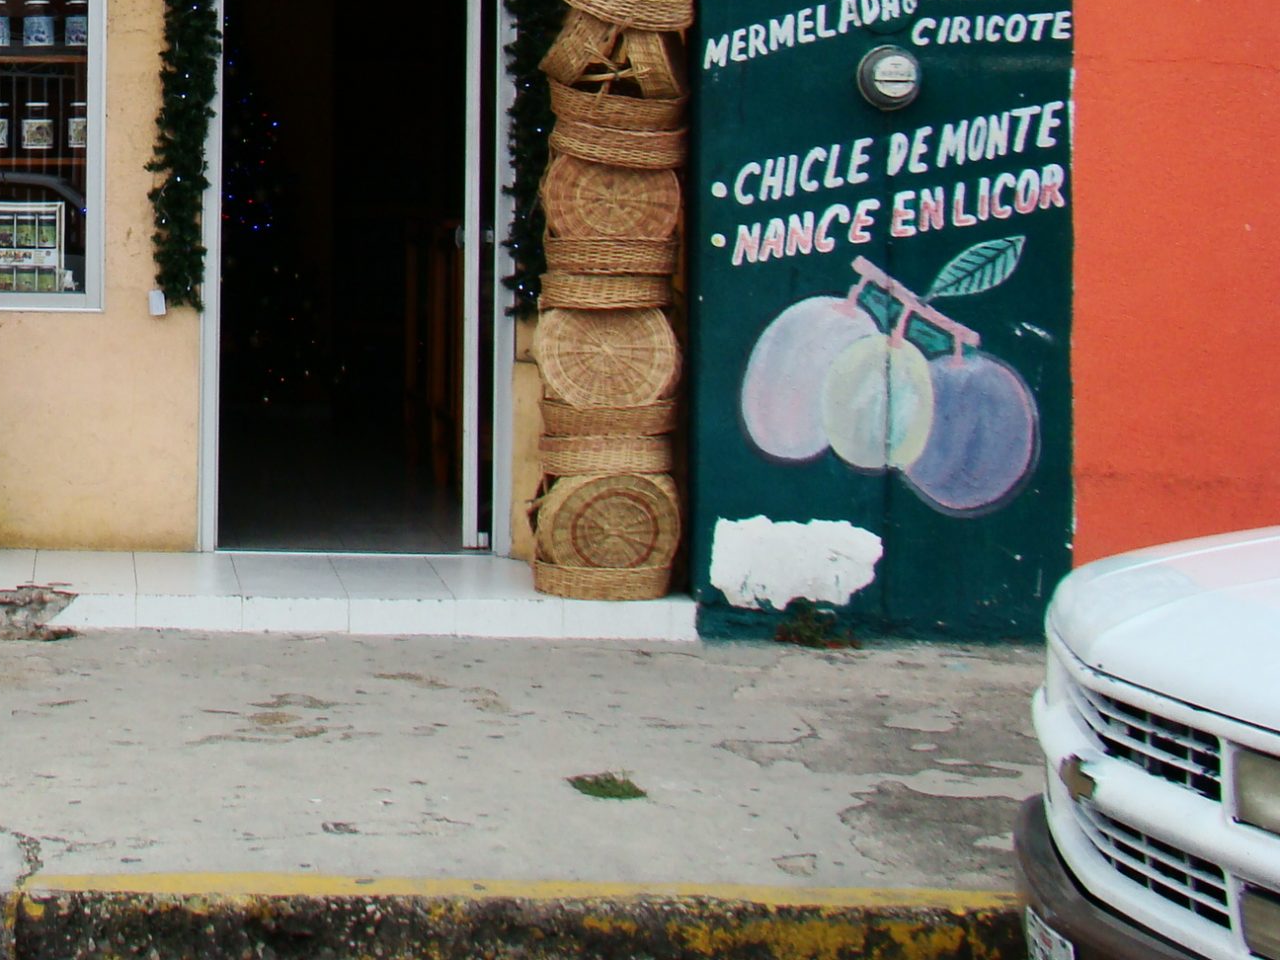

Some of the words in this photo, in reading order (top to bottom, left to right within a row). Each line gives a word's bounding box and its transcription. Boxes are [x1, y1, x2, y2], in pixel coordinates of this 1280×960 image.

[911, 10, 1073, 47] CIRICOTE
[733, 137, 874, 206] CHICLE
[886, 126, 933, 178] DE
[936, 100, 1065, 169] MONTE
[732, 197, 881, 266] NANCE
[890, 186, 945, 239] EN
[951, 163, 1066, 228] LICOR
